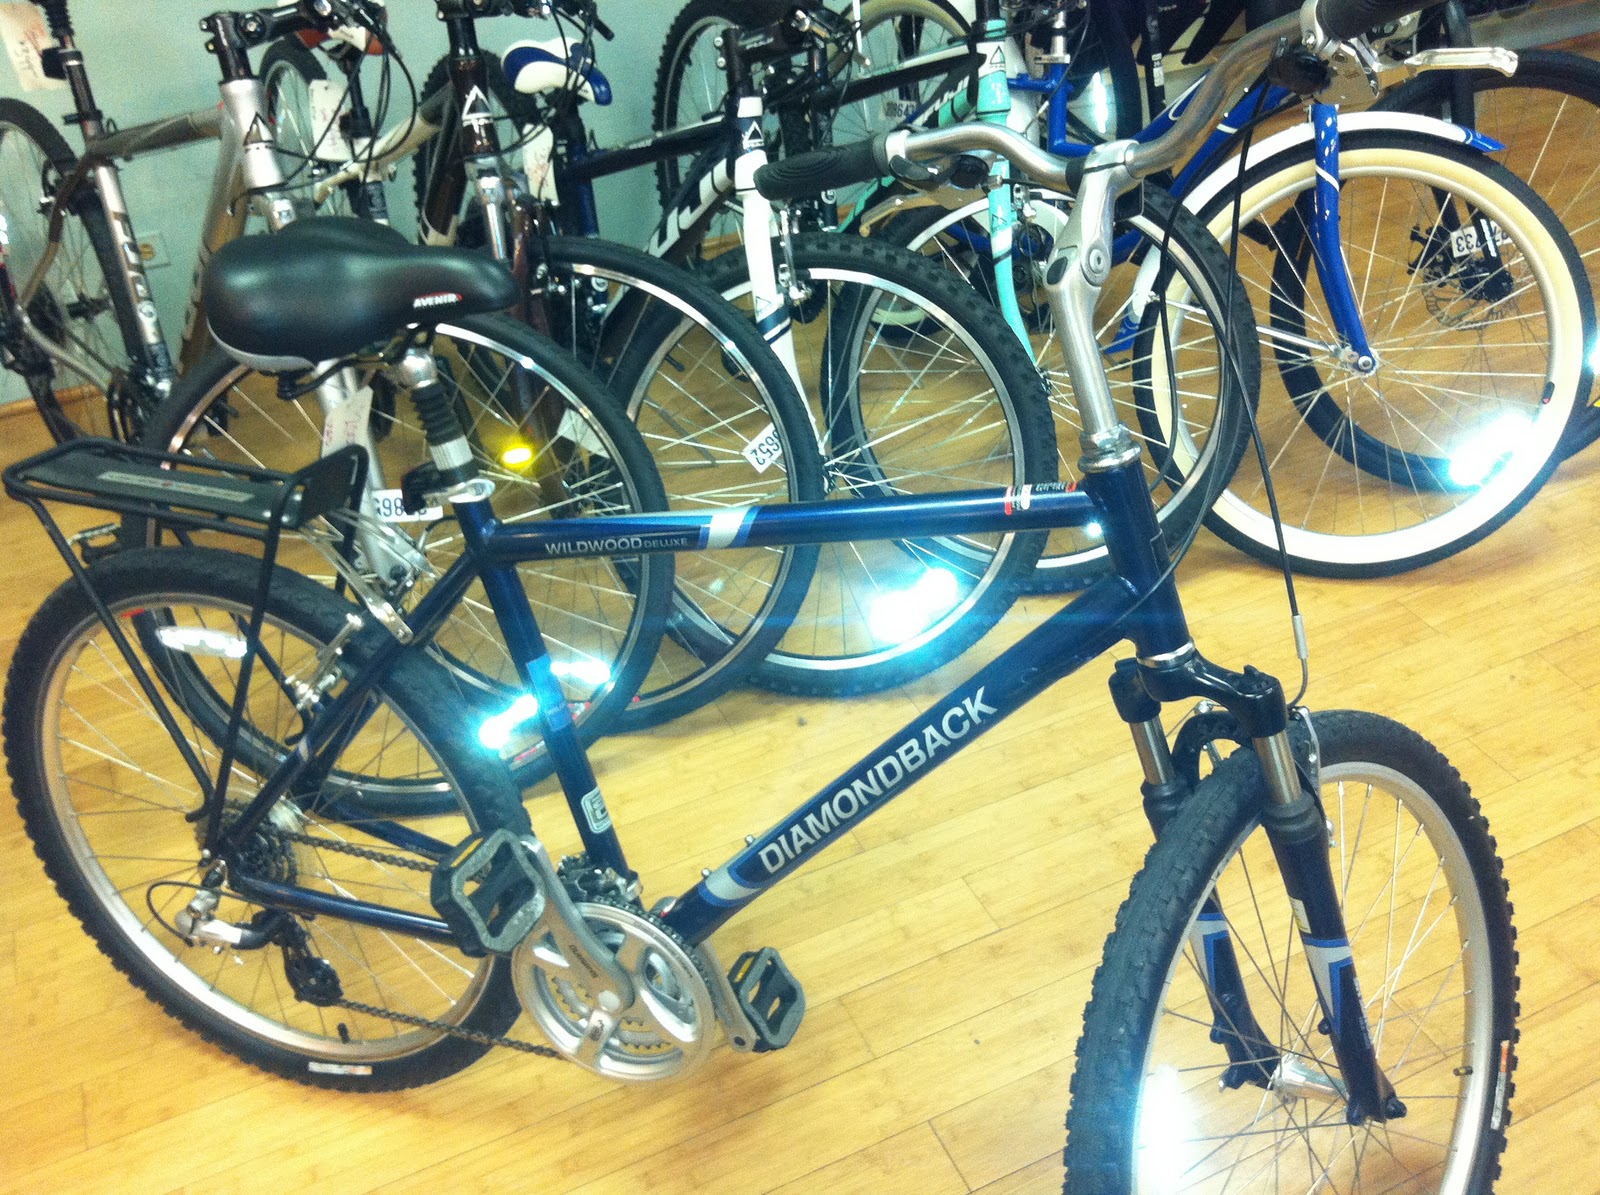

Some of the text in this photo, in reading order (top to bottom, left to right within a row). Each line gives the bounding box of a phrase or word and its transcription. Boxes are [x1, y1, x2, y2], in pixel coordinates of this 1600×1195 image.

[545, 536, 688, 555] WILDWOOD DELUXE
[758, 685, 999, 874] DIAMONDBACK
